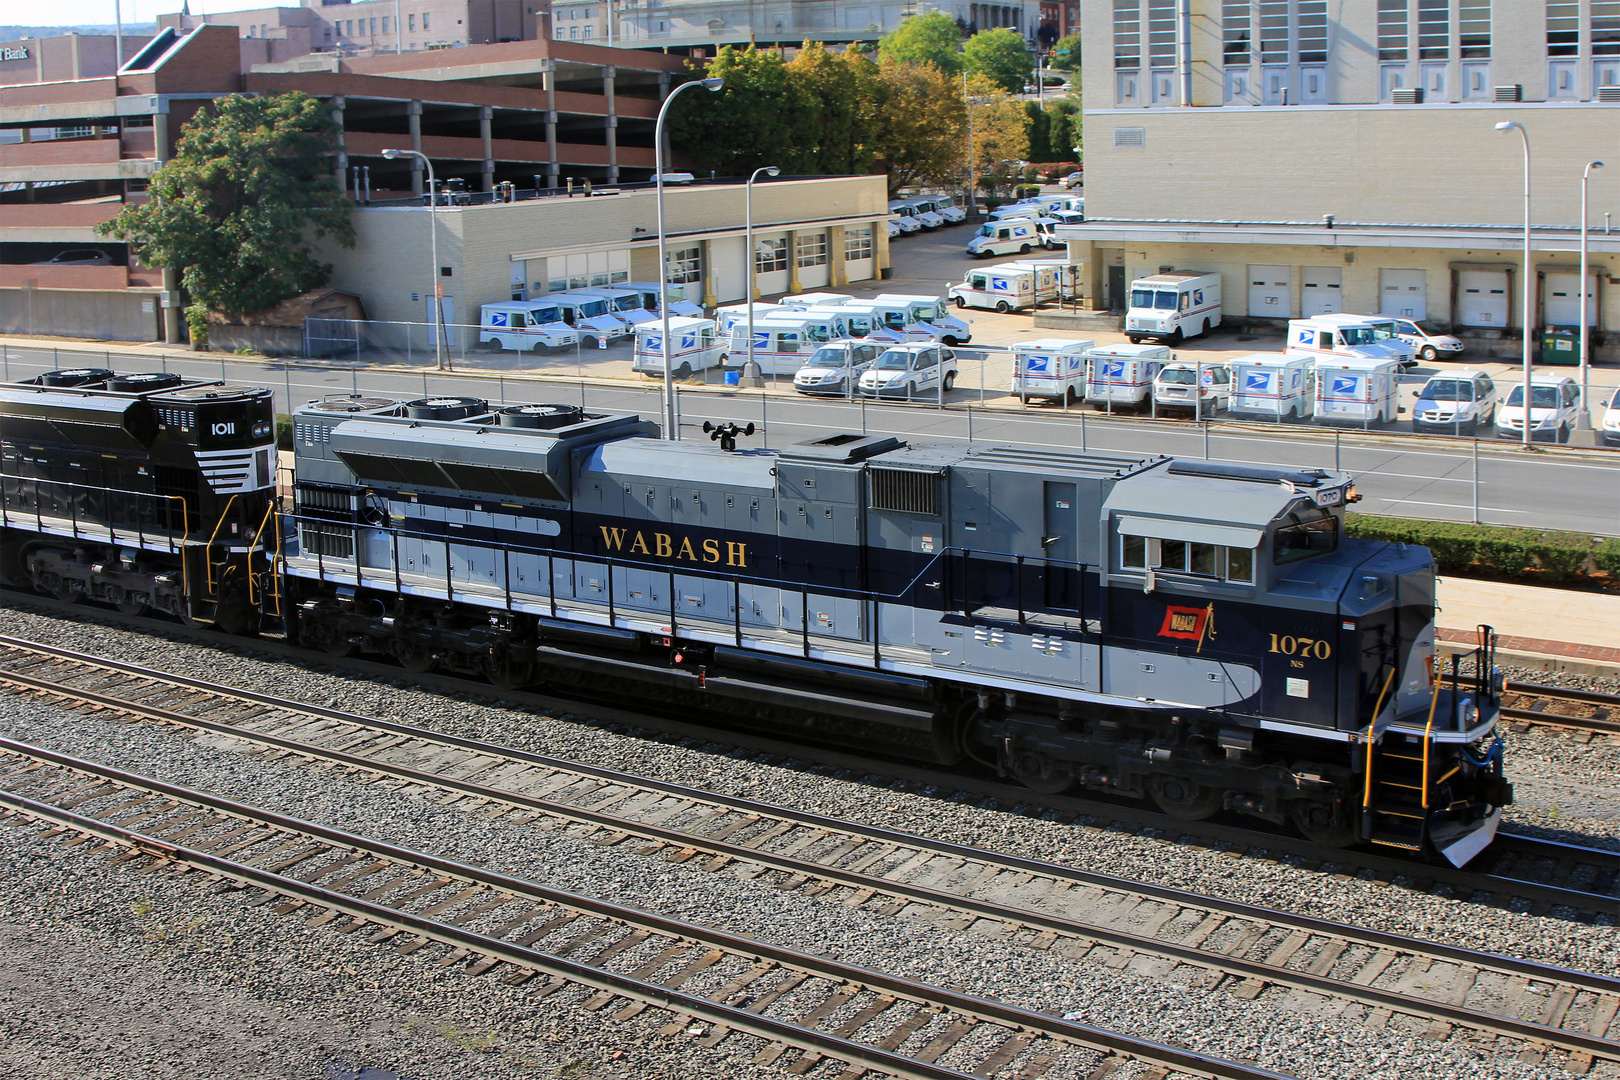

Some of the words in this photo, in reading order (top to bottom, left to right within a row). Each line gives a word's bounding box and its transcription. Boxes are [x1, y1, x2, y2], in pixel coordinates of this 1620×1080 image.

[5, 46, 28, 60] Bank
[211, 422, 235, 436] 1011
[1320, 491, 1337, 503] 1070
[599, 525, 748, 568] WABASH
[1267, 632, 1332, 660] 1070
[1290, 659, 1305, 669] NS
